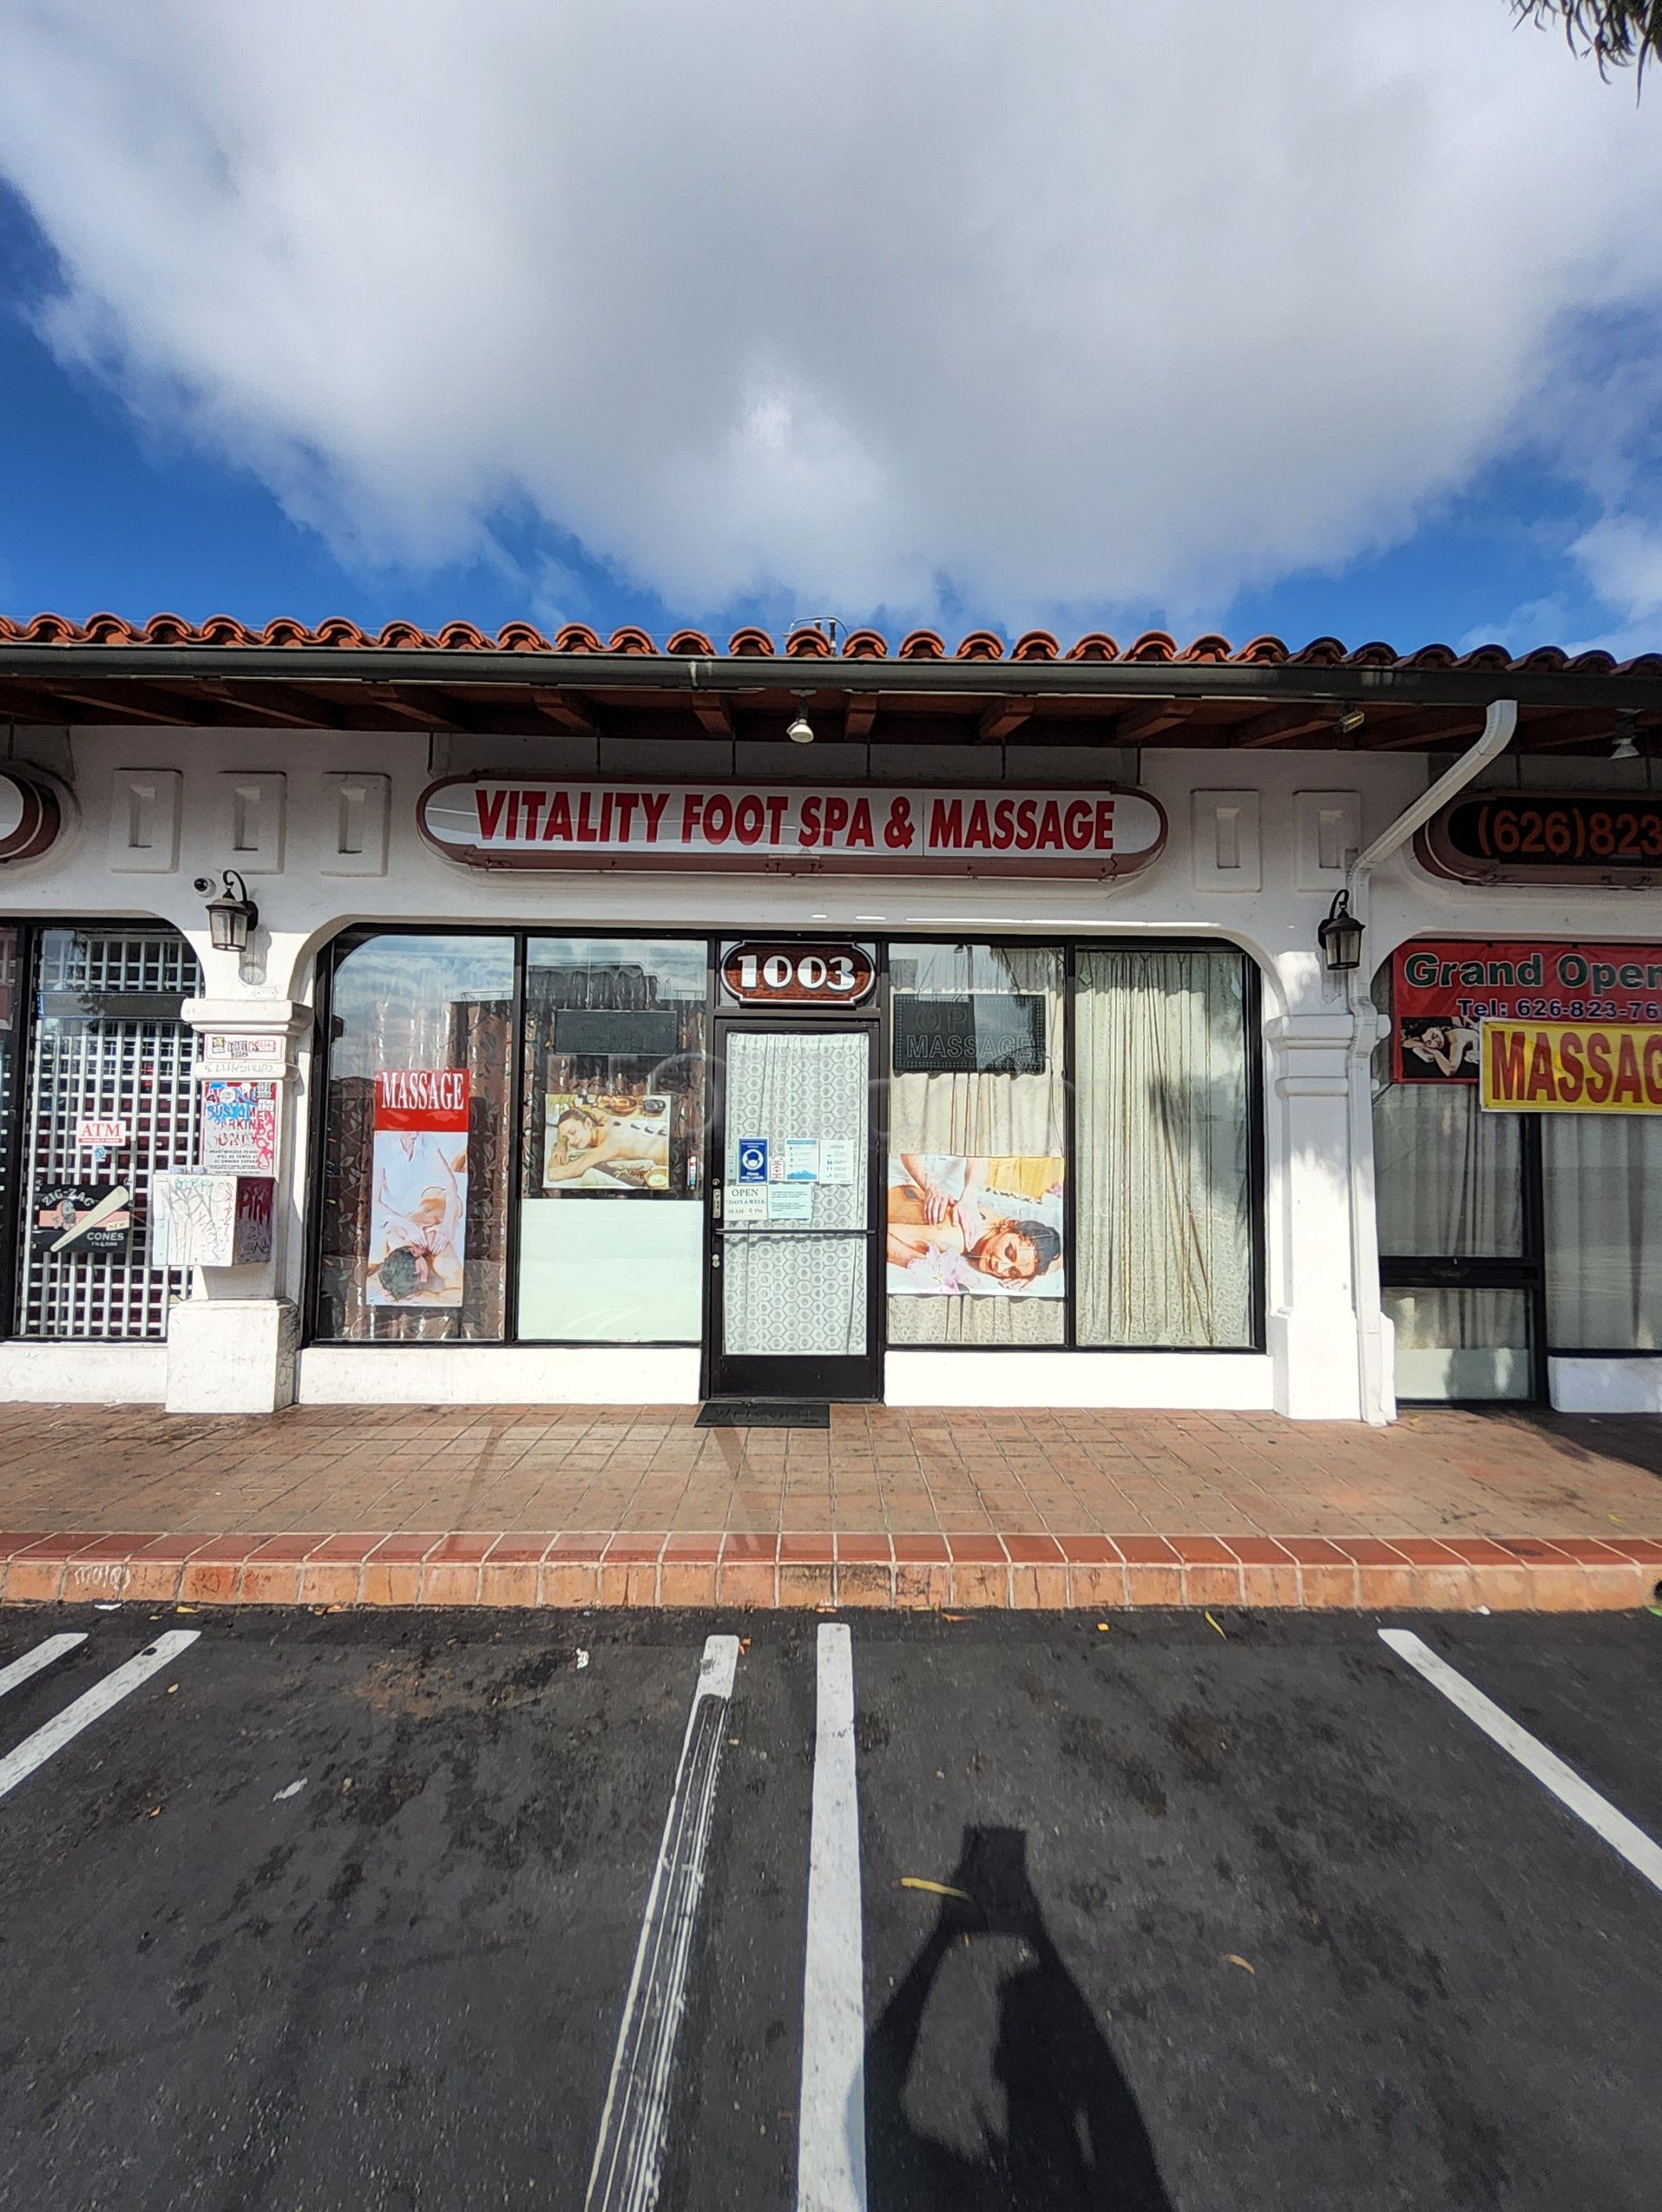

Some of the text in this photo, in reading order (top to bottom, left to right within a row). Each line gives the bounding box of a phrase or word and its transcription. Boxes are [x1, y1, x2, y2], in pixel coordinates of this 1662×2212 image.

[475, 789, 1116, 851] VITALITY FOOT SPA & MASSAGE
[1479, 806, 1662, 857] (626)823
[737, 955, 856, 990] 1003
[1404, 952, 1662, 996] Grand Open
[916, 1007, 1033, 1033] OPEN
[1456, 999, 1508, 1018] Tel:
[907, 1034, 1035, 1059] MASSAGE
[1491, 1030, 1662, 1104] MASSAG
[381, 1071, 464, 1110] MASSAGE
[81, 1123, 121, 1136] ATM
[86, 1232, 124, 1241] CONES
